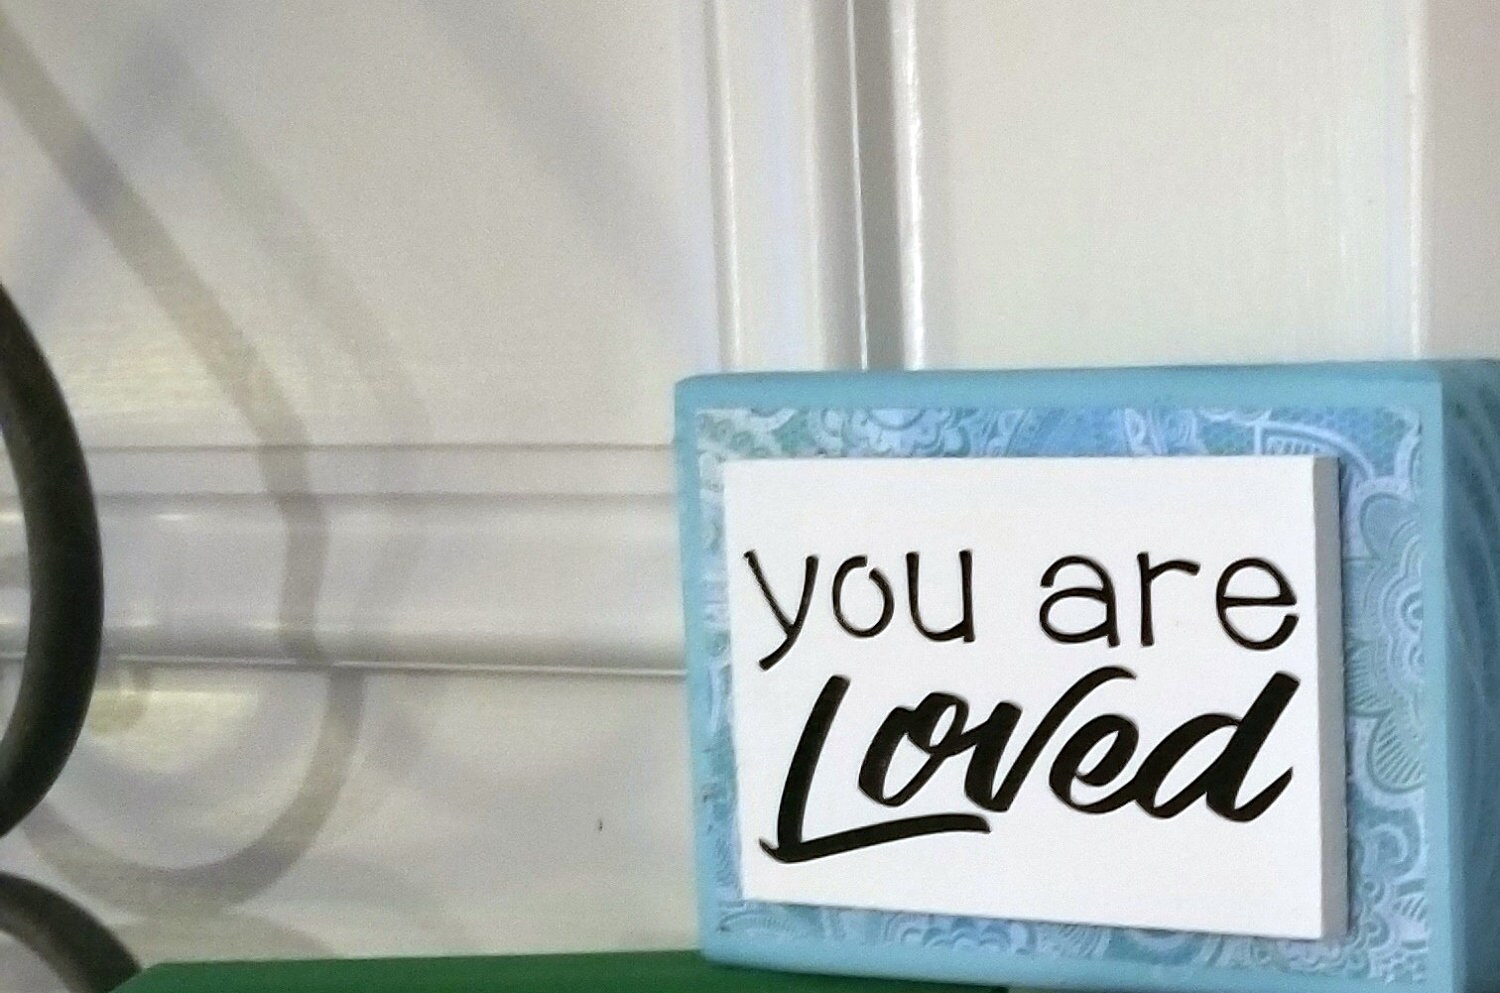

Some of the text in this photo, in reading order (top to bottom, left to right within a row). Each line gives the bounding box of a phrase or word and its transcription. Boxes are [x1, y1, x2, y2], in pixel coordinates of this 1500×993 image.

[743, 549, 1300, 672] you are
[758, 665, 1301, 864] Loved
